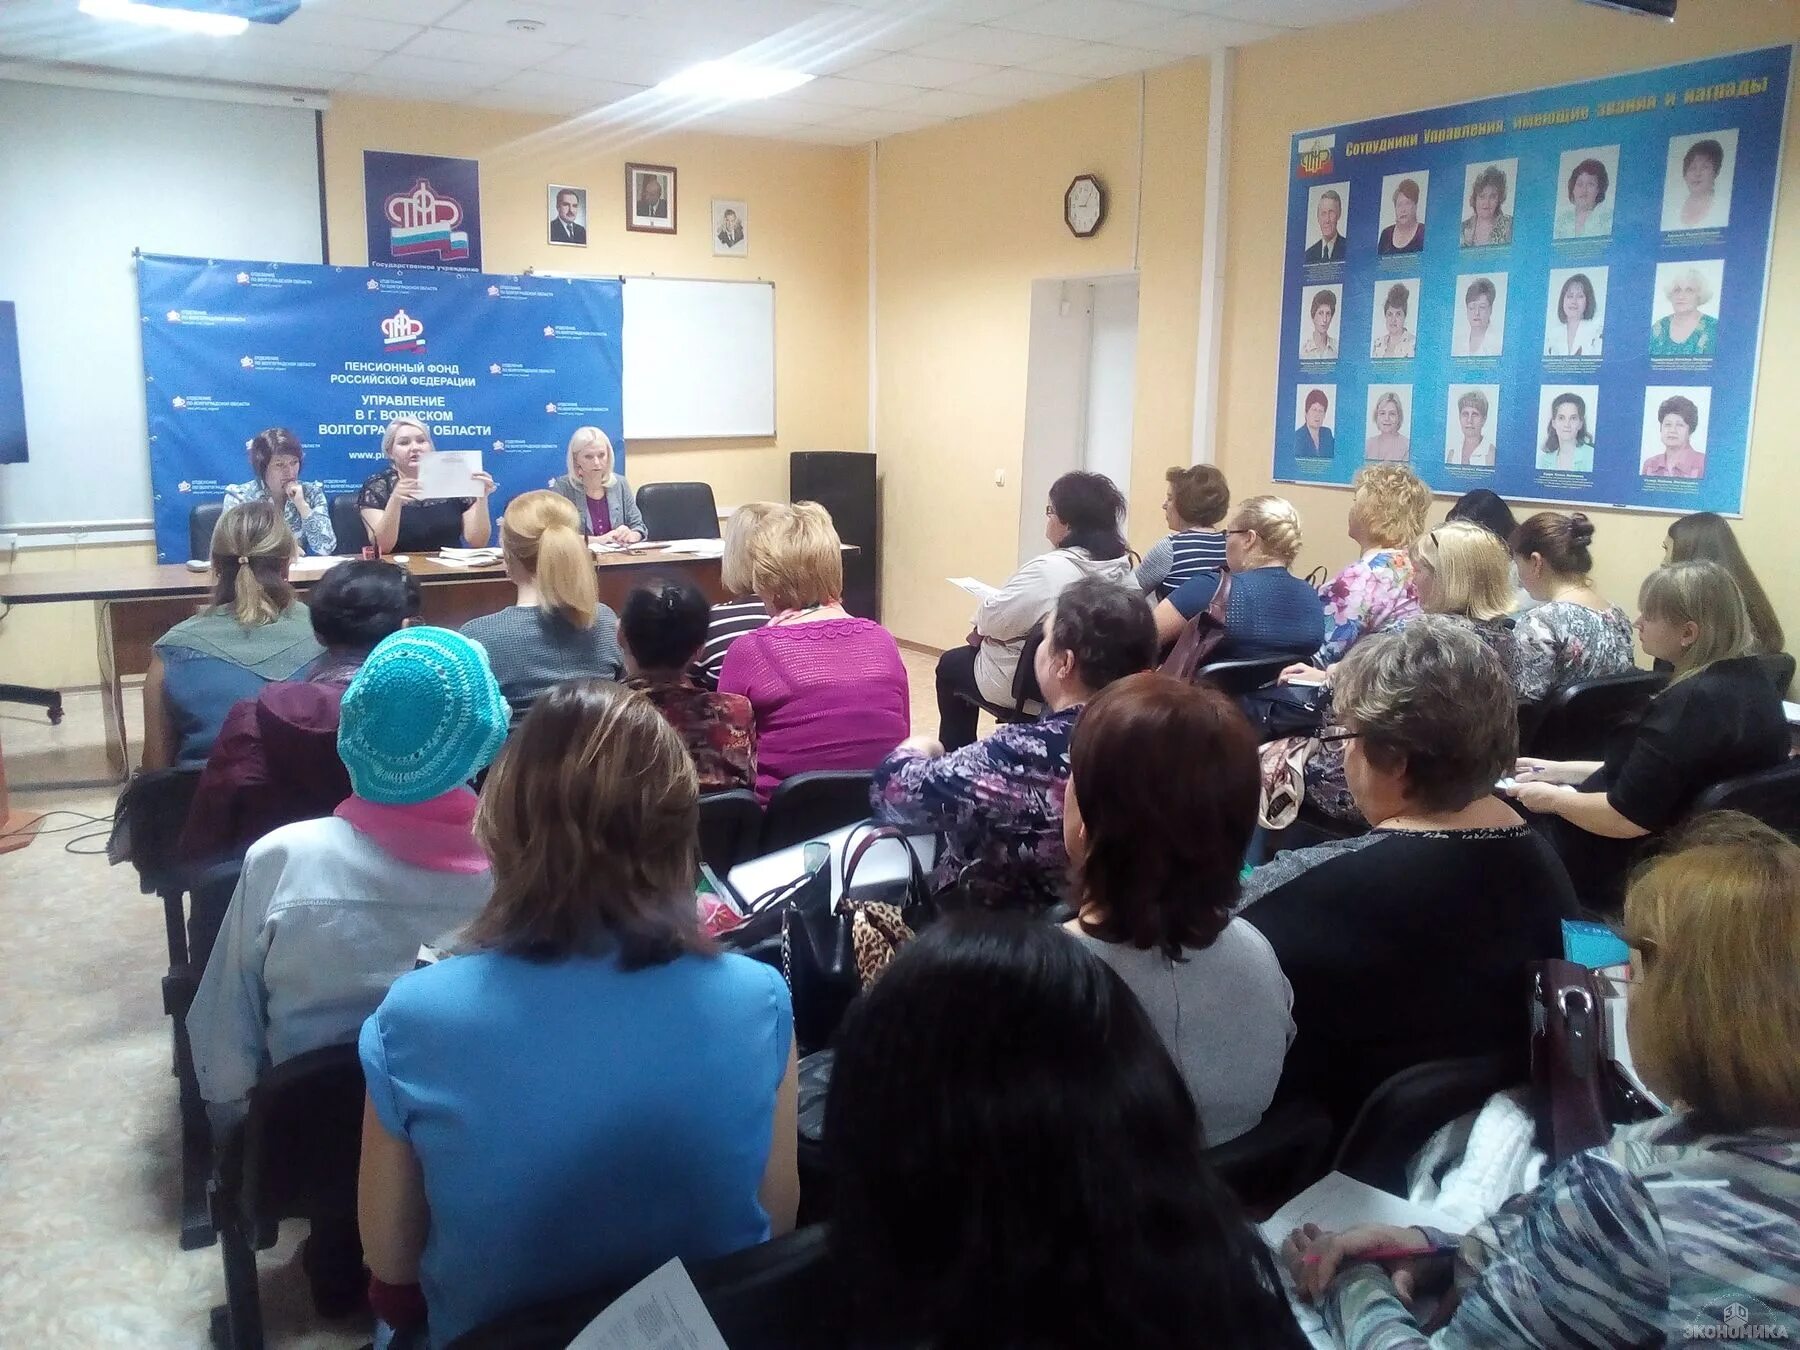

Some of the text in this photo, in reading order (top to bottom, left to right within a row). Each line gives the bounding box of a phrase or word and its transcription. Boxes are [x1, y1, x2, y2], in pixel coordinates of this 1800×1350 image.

[1345, 132, 1418, 157] Сотрудники
[372, 260, 435, 270] Государственное
[344, 361, 460, 375] ПЕНСИОННЫЙ ФОНД
[330, 374, 476, 387] РОССИЙСКОЙ ФЕДЕРАЦИИ
[361, 395, 446, 407] УПРАВЛЕНИЕ
[355, 410, 453, 421] В Г. ВОЛЖСКОМ
[319, 424, 492, 436] ВОЛГОГРА ОБЛАСТИ
